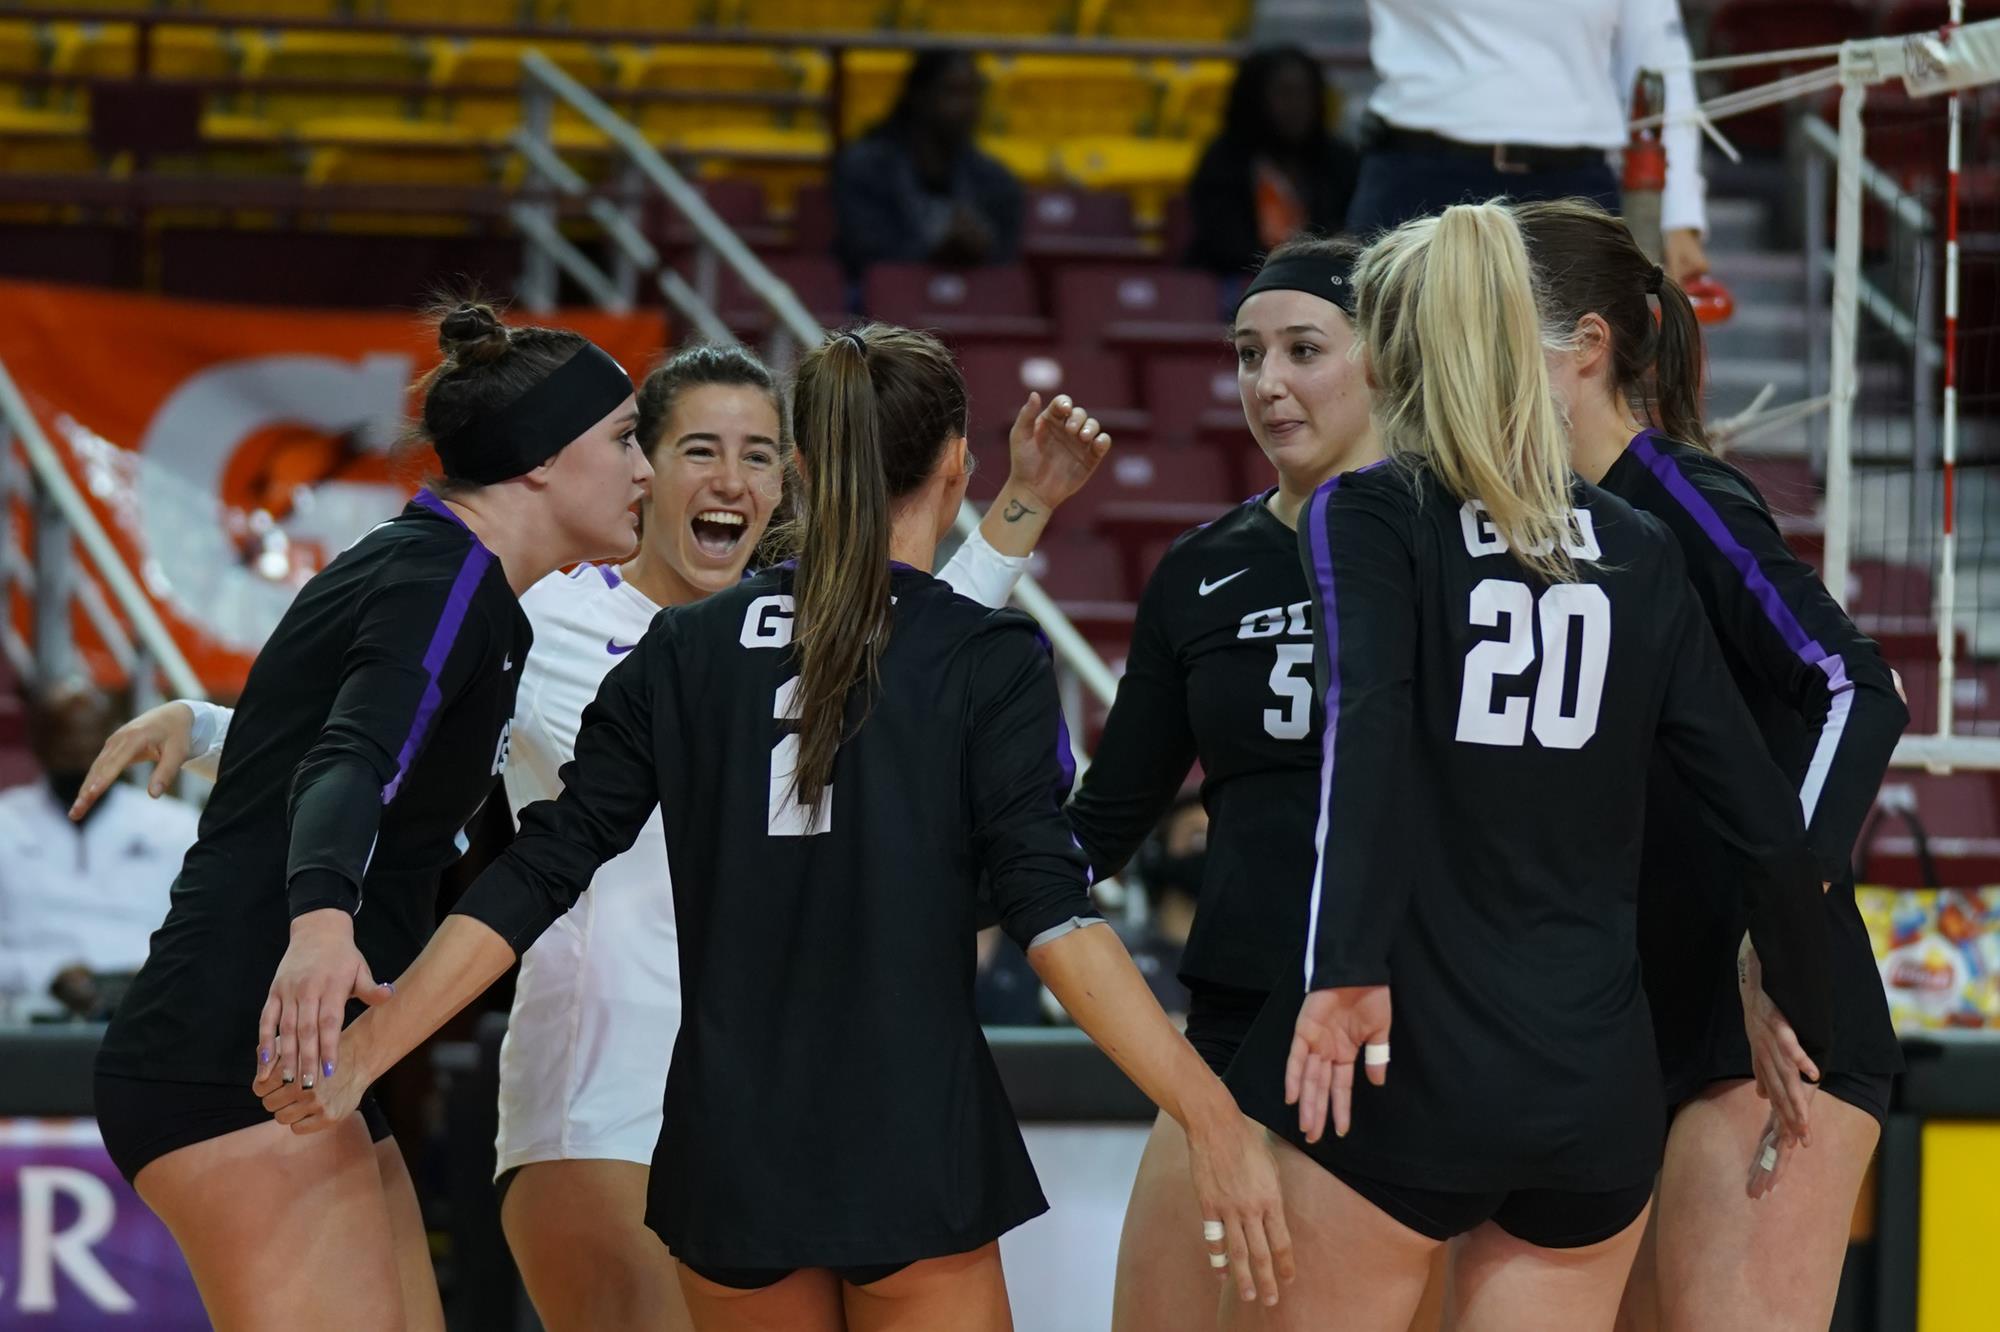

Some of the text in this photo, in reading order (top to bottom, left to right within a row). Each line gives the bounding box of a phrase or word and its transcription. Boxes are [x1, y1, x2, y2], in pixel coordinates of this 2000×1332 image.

[1263, 643, 1314, 740] 5
[1456, 579, 1612, 749] 20
[0, 1165, 137, 1313] R
